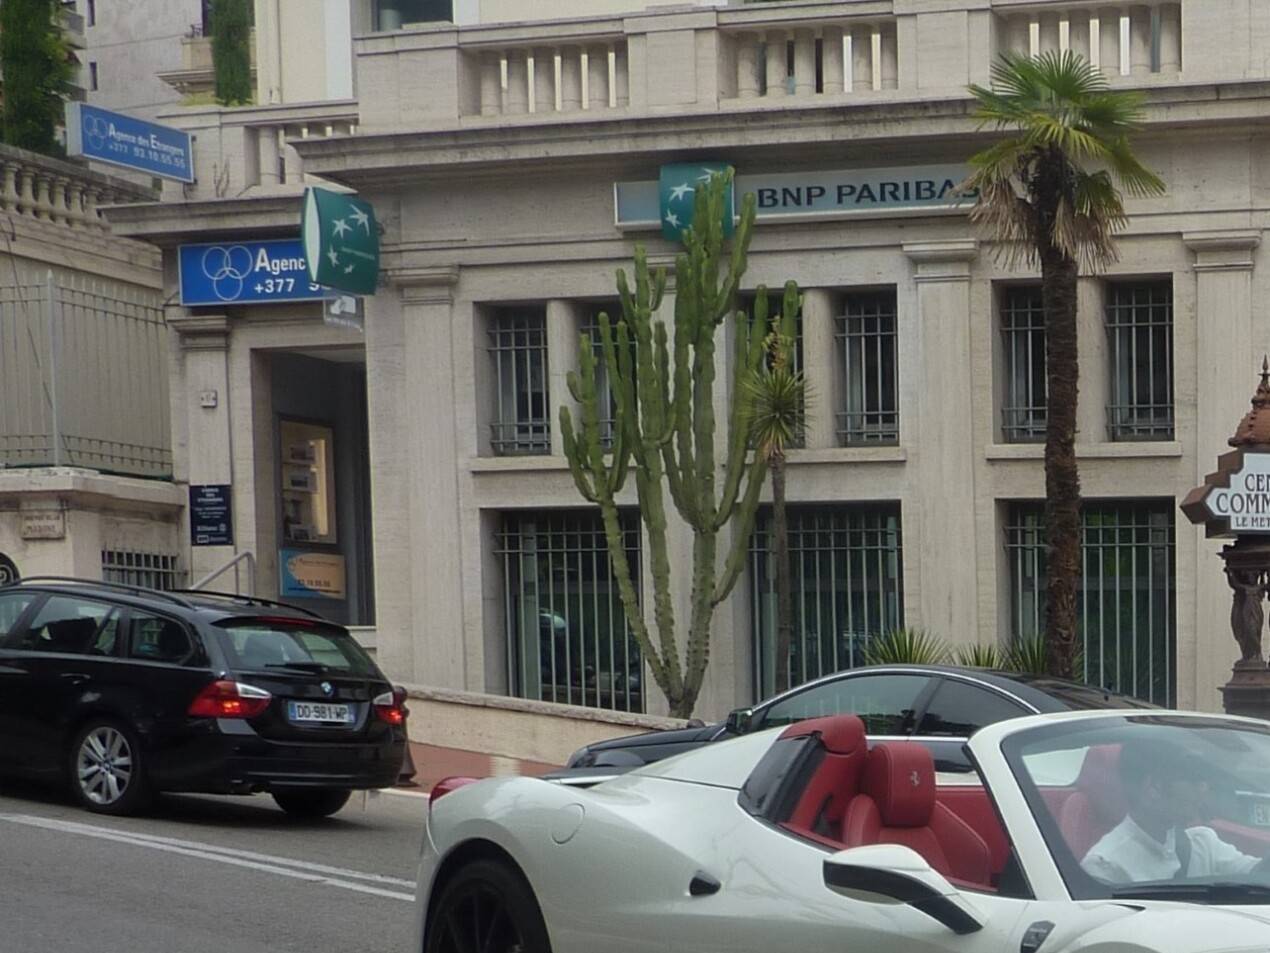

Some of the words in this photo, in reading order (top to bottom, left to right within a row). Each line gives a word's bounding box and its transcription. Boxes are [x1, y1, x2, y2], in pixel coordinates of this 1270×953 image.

[138, 135, 149, 146] des
[757, 186, 826, 208] BNP
[254, 248, 306, 275] Agenc
[254, 279, 295, 293] +377
[1236, 516, 1248, 527] LE
